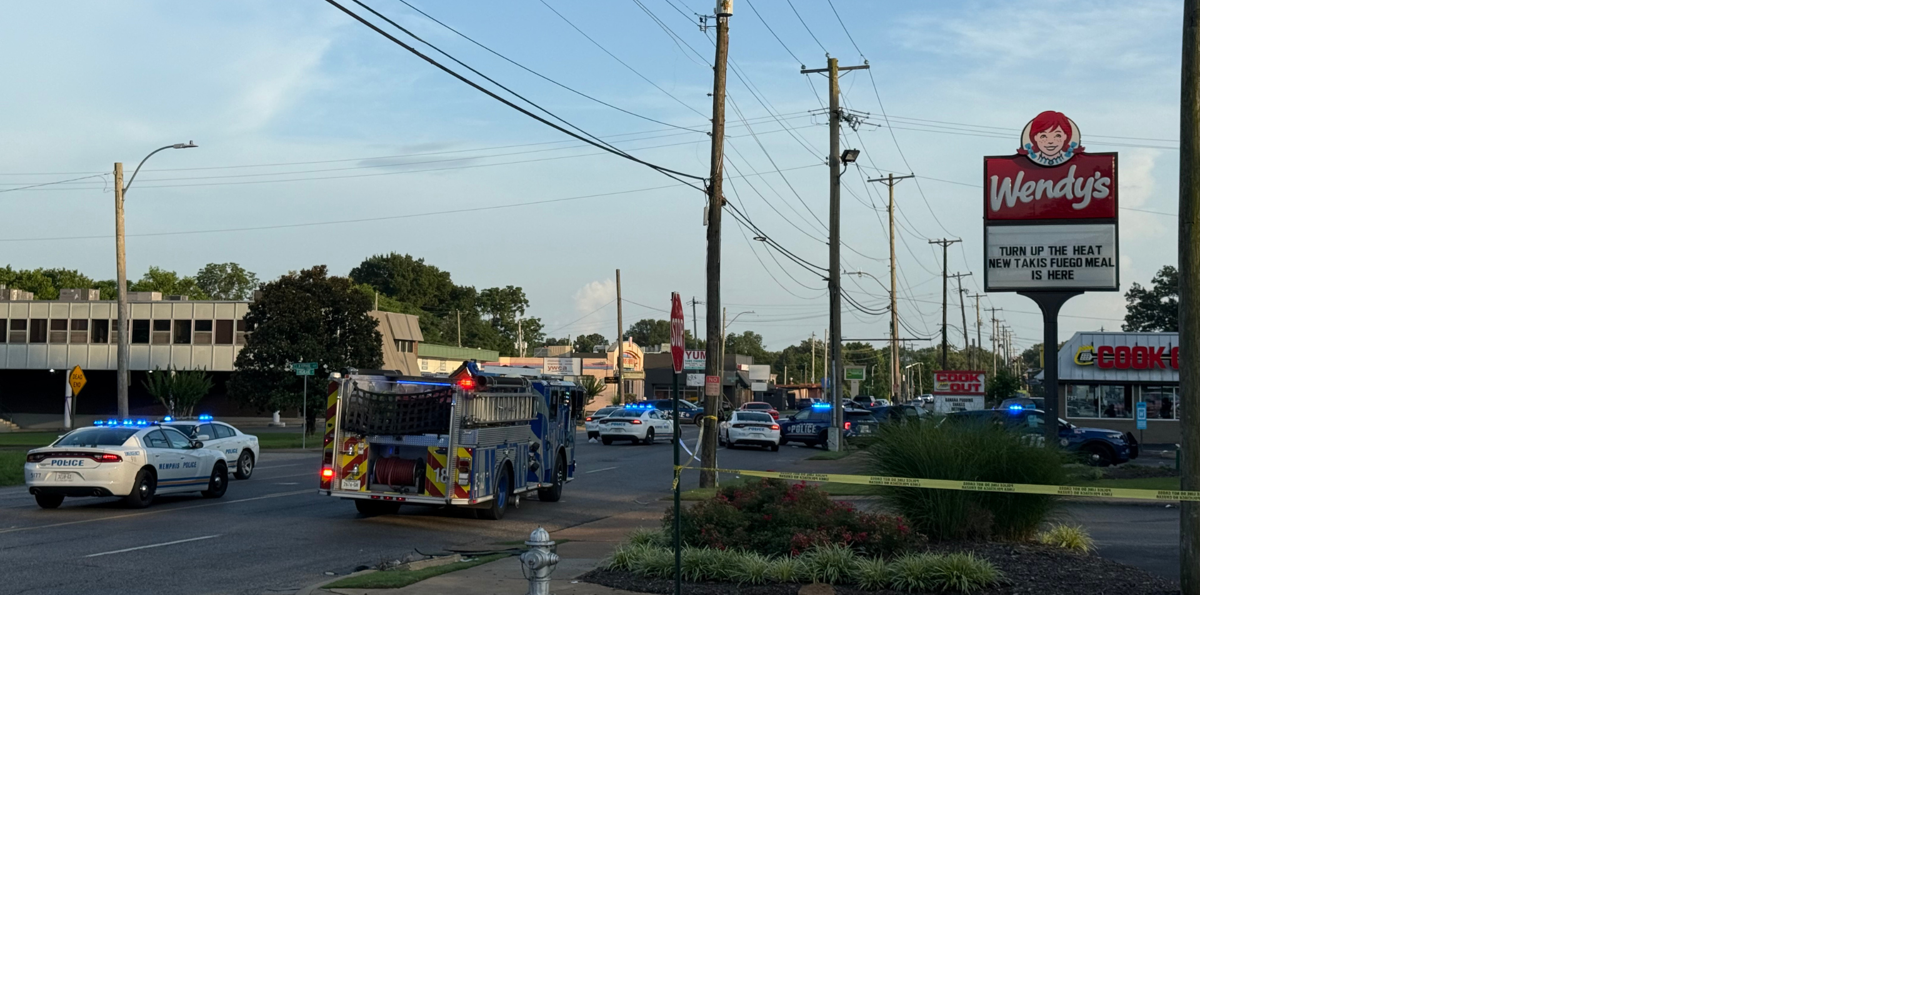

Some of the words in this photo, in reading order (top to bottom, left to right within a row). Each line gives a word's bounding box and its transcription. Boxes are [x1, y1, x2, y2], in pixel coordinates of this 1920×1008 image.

[990, 165, 1110, 212] Wendy's
[999, 246, 1026, 256] TURN
[1031, 246, 1044, 256] UP
[1048, 246, 1068, 256] THE
[1073, 245, 1102, 256] HEAT
[988, 258, 1010, 268] NEW
[1014, 258, 1047, 268] TAKIS
[1050, 258, 1082, 268] FUEGO
[1085, 257, 1114, 268] MEAL
[1031, 270, 1042, 280] IS
[1048, 270, 1074, 280] HERE
[672, 318, 684, 347] STOP
[1098, 346, 1166, 369] COOK
[936, 374, 981, 382] COOK
[950, 383, 981, 391] OUT
[791, 424, 816, 434] POLICE
[433, 467, 447, 483] 18
